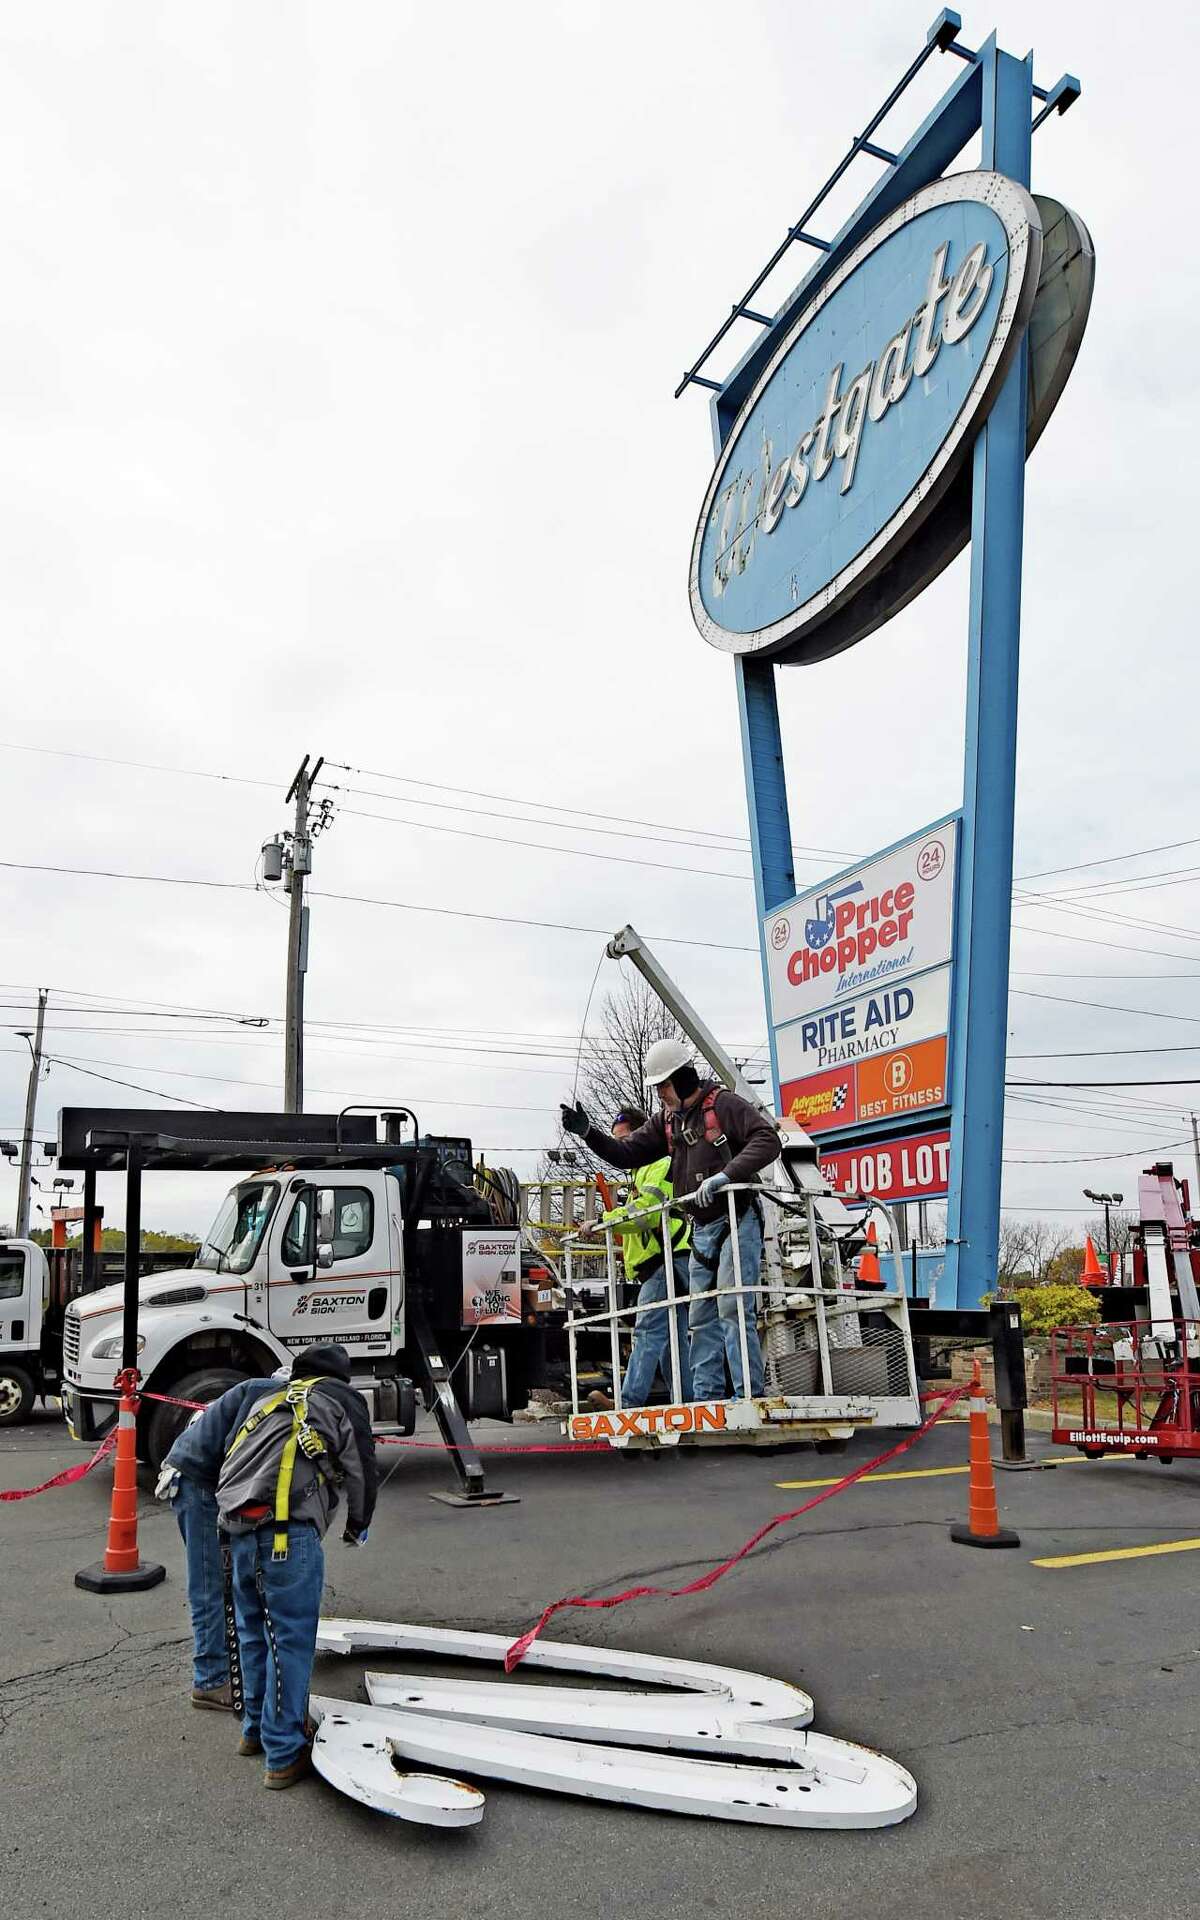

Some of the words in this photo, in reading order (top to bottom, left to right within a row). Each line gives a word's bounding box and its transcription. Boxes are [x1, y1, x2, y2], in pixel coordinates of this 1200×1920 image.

[922, 847, 940, 868] 24
[835, 882, 915, 939] Price
[774, 923, 787, 939] 24
[787, 909, 914, 987] Chopper
[835, 946, 914, 993] International
[802, 1006, 857, 1052] RITE
[864, 987, 914, 1032] AID
[817, 1027, 899, 1067] PHARMACY
[892, 1060, 906, 1088] B
[790, 1091, 832, 1111] Advance
[807, 1102, 832, 1118] Parts
[860, 1100, 888, 1118] BEST
[892, 1086, 943, 1110] FITNESS
[820, 1162, 838, 1181] EAN
[844, 1152, 893, 1194] JOB
[901, 1141, 950, 1188] LOT
[254, 1283, 264, 1291] 31
[310, 1307, 336, 1315] SIGN
[312, 1296, 366, 1307] SAXTON
[286, 1336, 301, 1345] NEW
[301, 1336, 317, 1344] YORK
[321, 1335, 334, 1343] NEW
[335, 1334, 360, 1343] ENGLAND
[364, 1333, 387, 1341] FLORIDA
[571, 1404, 727, 1439] SAXTON
[1069, 1432, 1158, 1445] ElliottEquip.com
